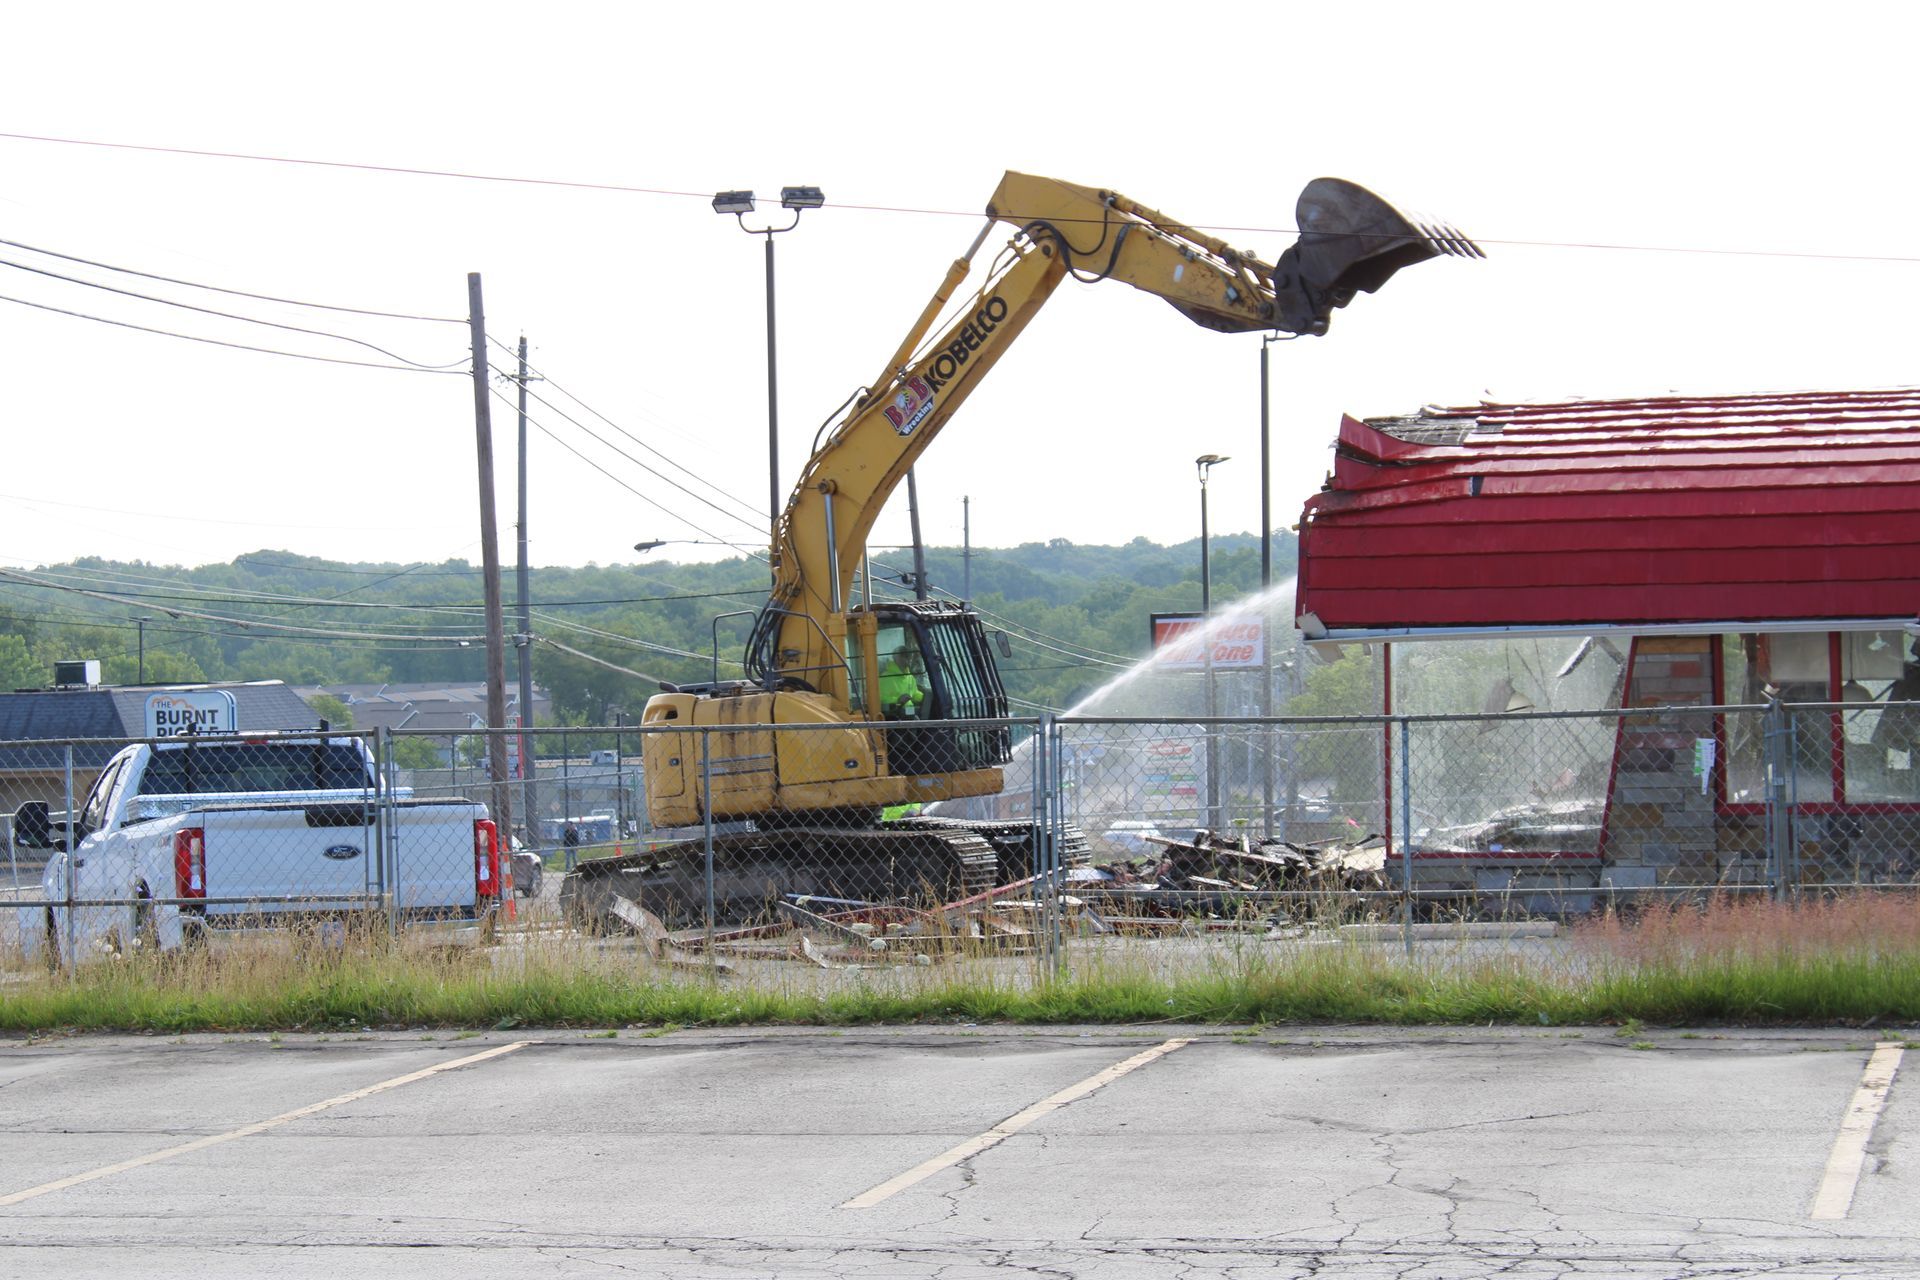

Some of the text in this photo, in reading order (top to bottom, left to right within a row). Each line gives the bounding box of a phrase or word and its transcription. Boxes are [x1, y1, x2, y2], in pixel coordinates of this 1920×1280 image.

[922, 296, 1008, 394] KOBELCO
[902, 401, 933, 434] Wrecking
[156, 701, 172, 709] THE
[156, 709, 219, 725] BURNT
